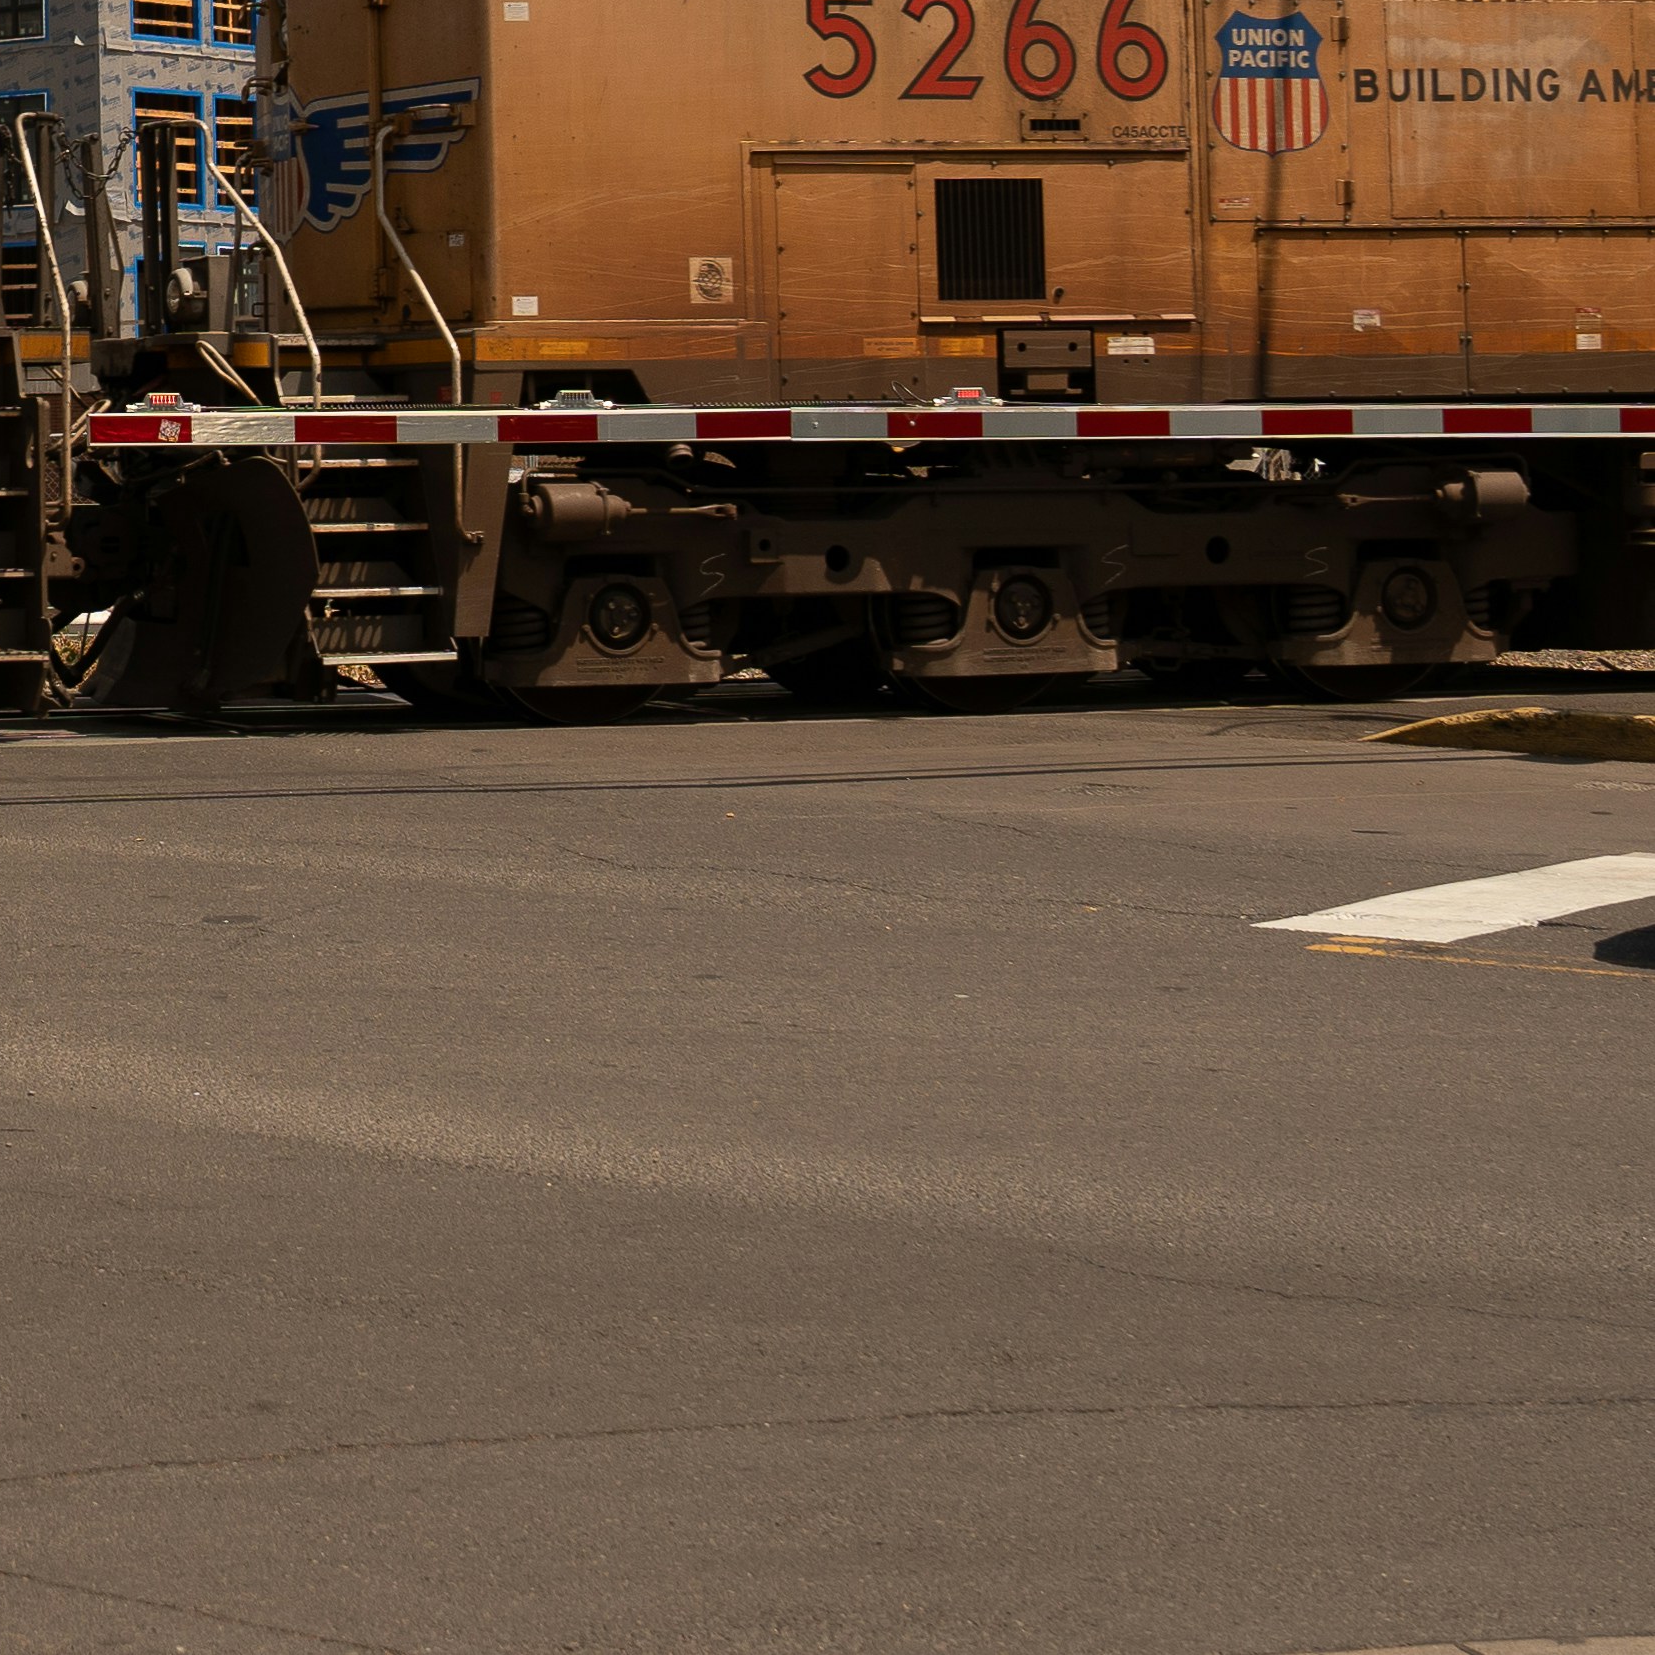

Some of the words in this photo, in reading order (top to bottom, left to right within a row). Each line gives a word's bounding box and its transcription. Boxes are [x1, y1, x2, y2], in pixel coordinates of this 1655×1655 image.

[1231, 28, 1305, 47] UNION
[1228, 48, 1310, 69] PACIFIC
[1353, 68, 1561, 103] BUILDING
[1577, 68, 1655, 103] AME
[1112, 125, 1186, 138] C45ACCTE
